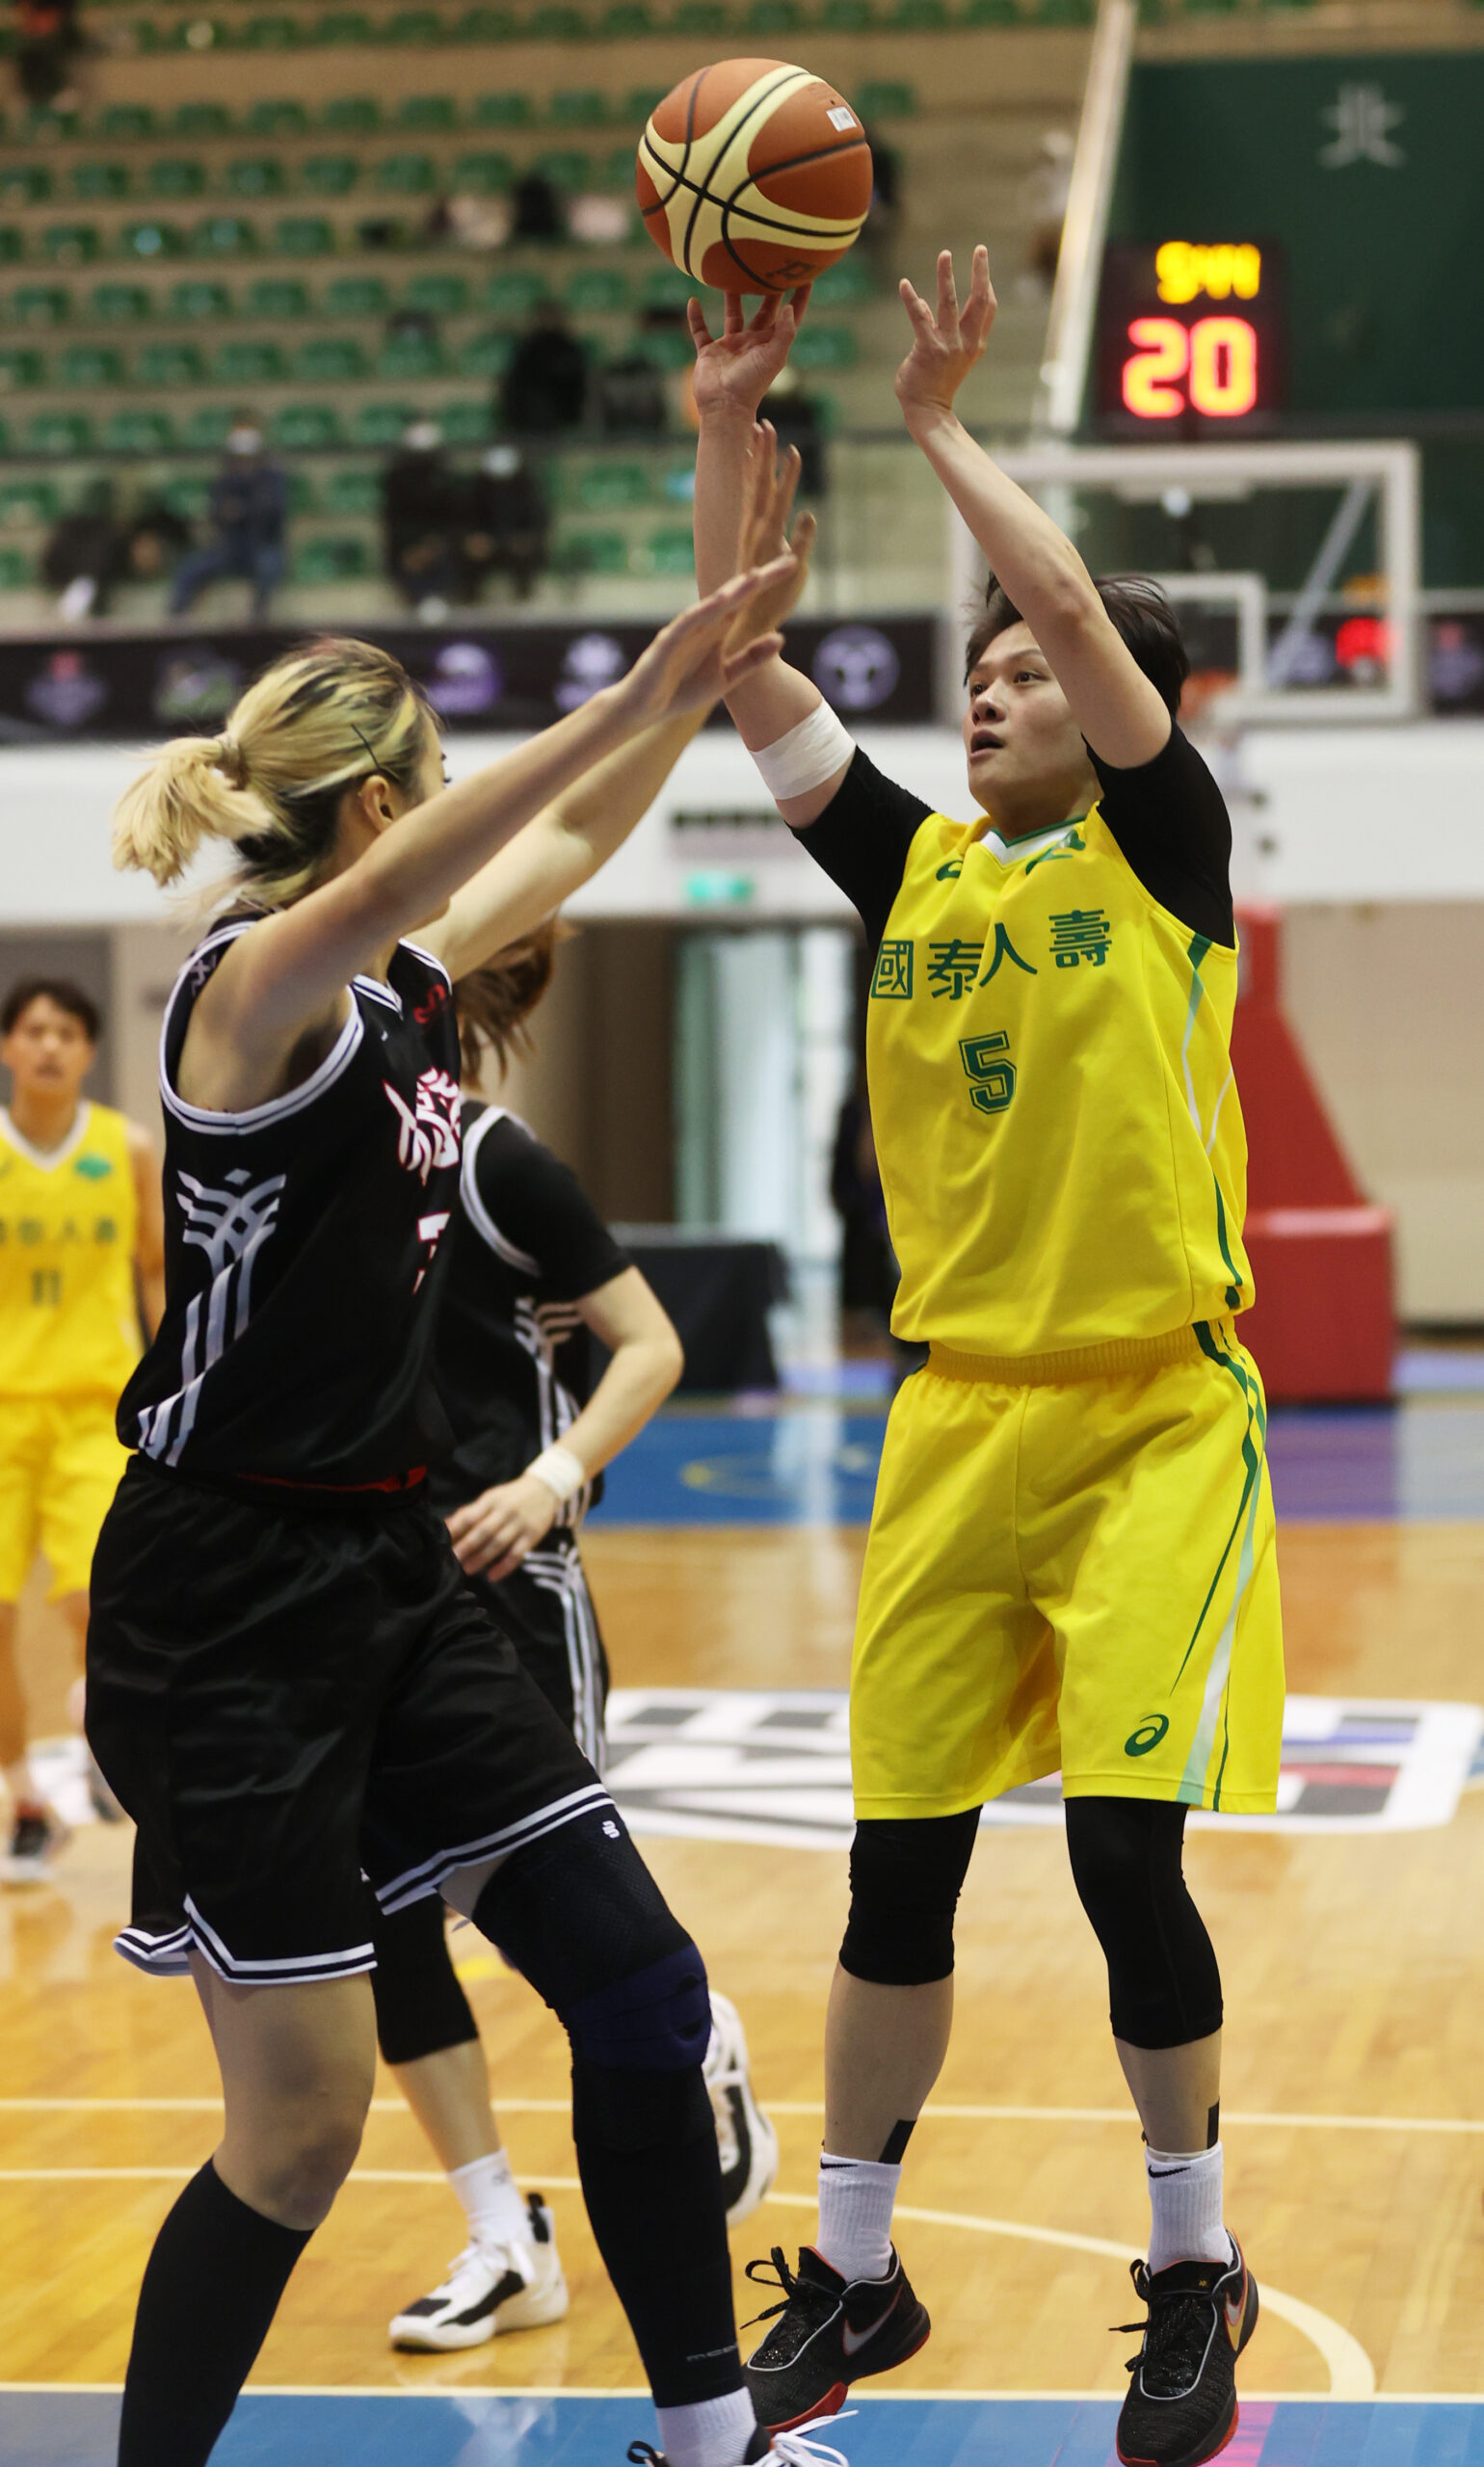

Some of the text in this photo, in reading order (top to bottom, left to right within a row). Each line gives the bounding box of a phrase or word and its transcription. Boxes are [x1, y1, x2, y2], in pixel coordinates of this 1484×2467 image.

[1122, 316, 1258, 418] 20
[870, 909, 1113, 1000] 國泰人壽
[958, 1029, 1018, 1116] 5
